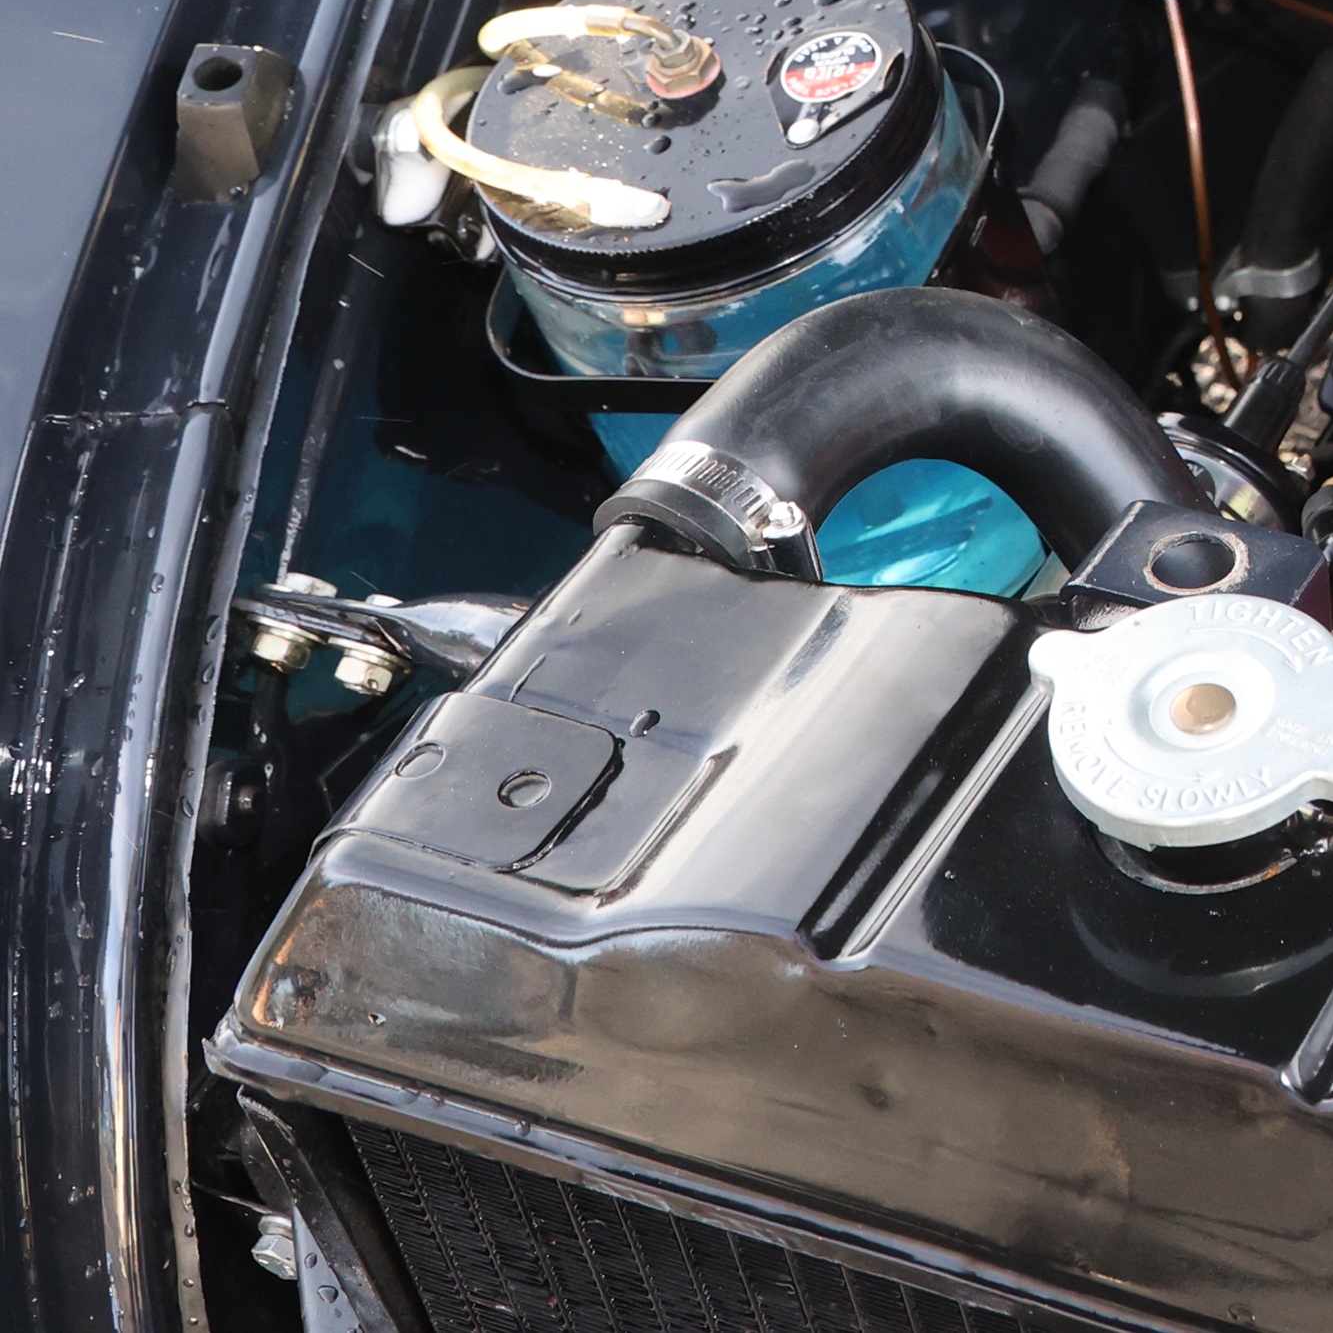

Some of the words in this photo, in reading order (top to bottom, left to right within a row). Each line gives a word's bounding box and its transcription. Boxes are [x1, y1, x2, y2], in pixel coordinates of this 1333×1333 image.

[803, 63, 856, 80] TRICO
[1275, 717, 1312, 736] MADE
[1266, 727, 1330, 756] ENGLAND
[1060, 701, 1131, 800] REMOVE
[1140, 767, 1276, 812] SLOWLY
